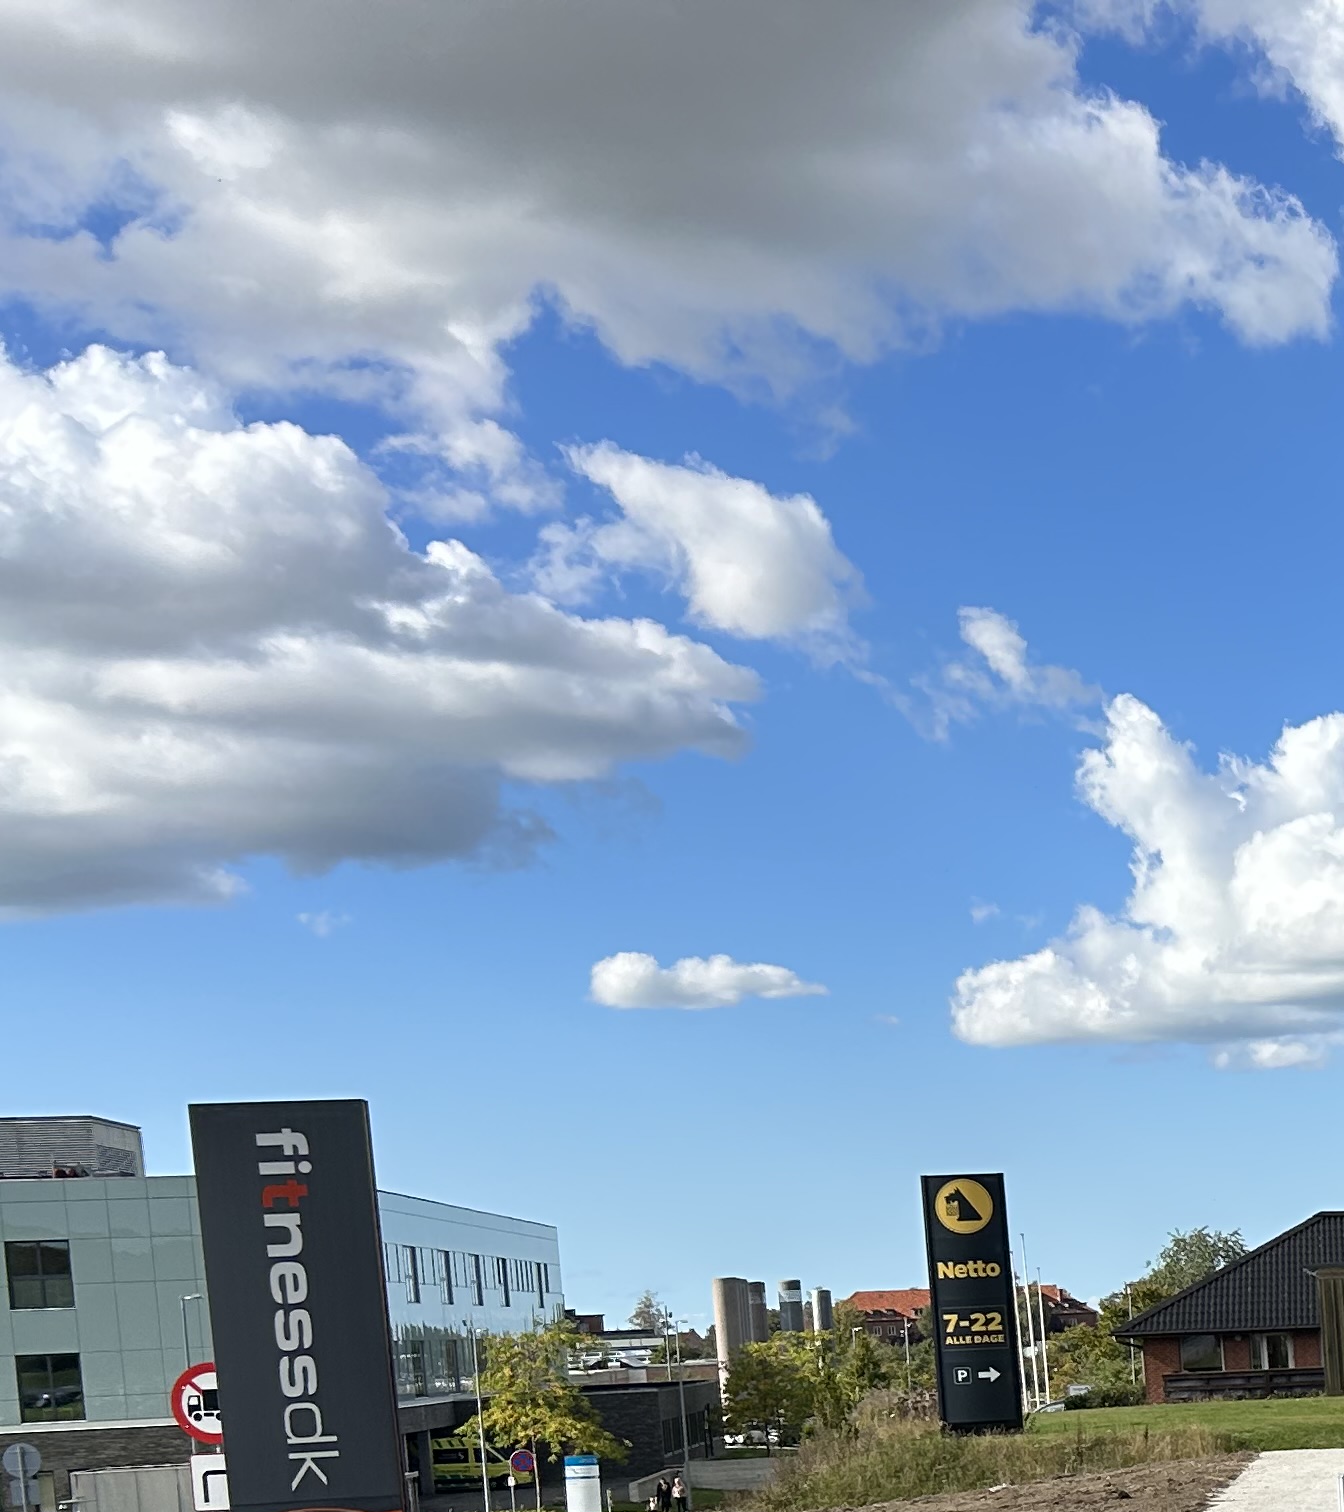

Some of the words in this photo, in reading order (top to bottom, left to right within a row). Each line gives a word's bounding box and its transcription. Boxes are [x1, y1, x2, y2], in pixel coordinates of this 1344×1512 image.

[936, 1260, 1001, 1280] Netto
[942, 1312, 1003, 1334] 7-22
[945, 1335, 973, 1345] ALLE
[974, 1334, 1005, 1344] DAGE
